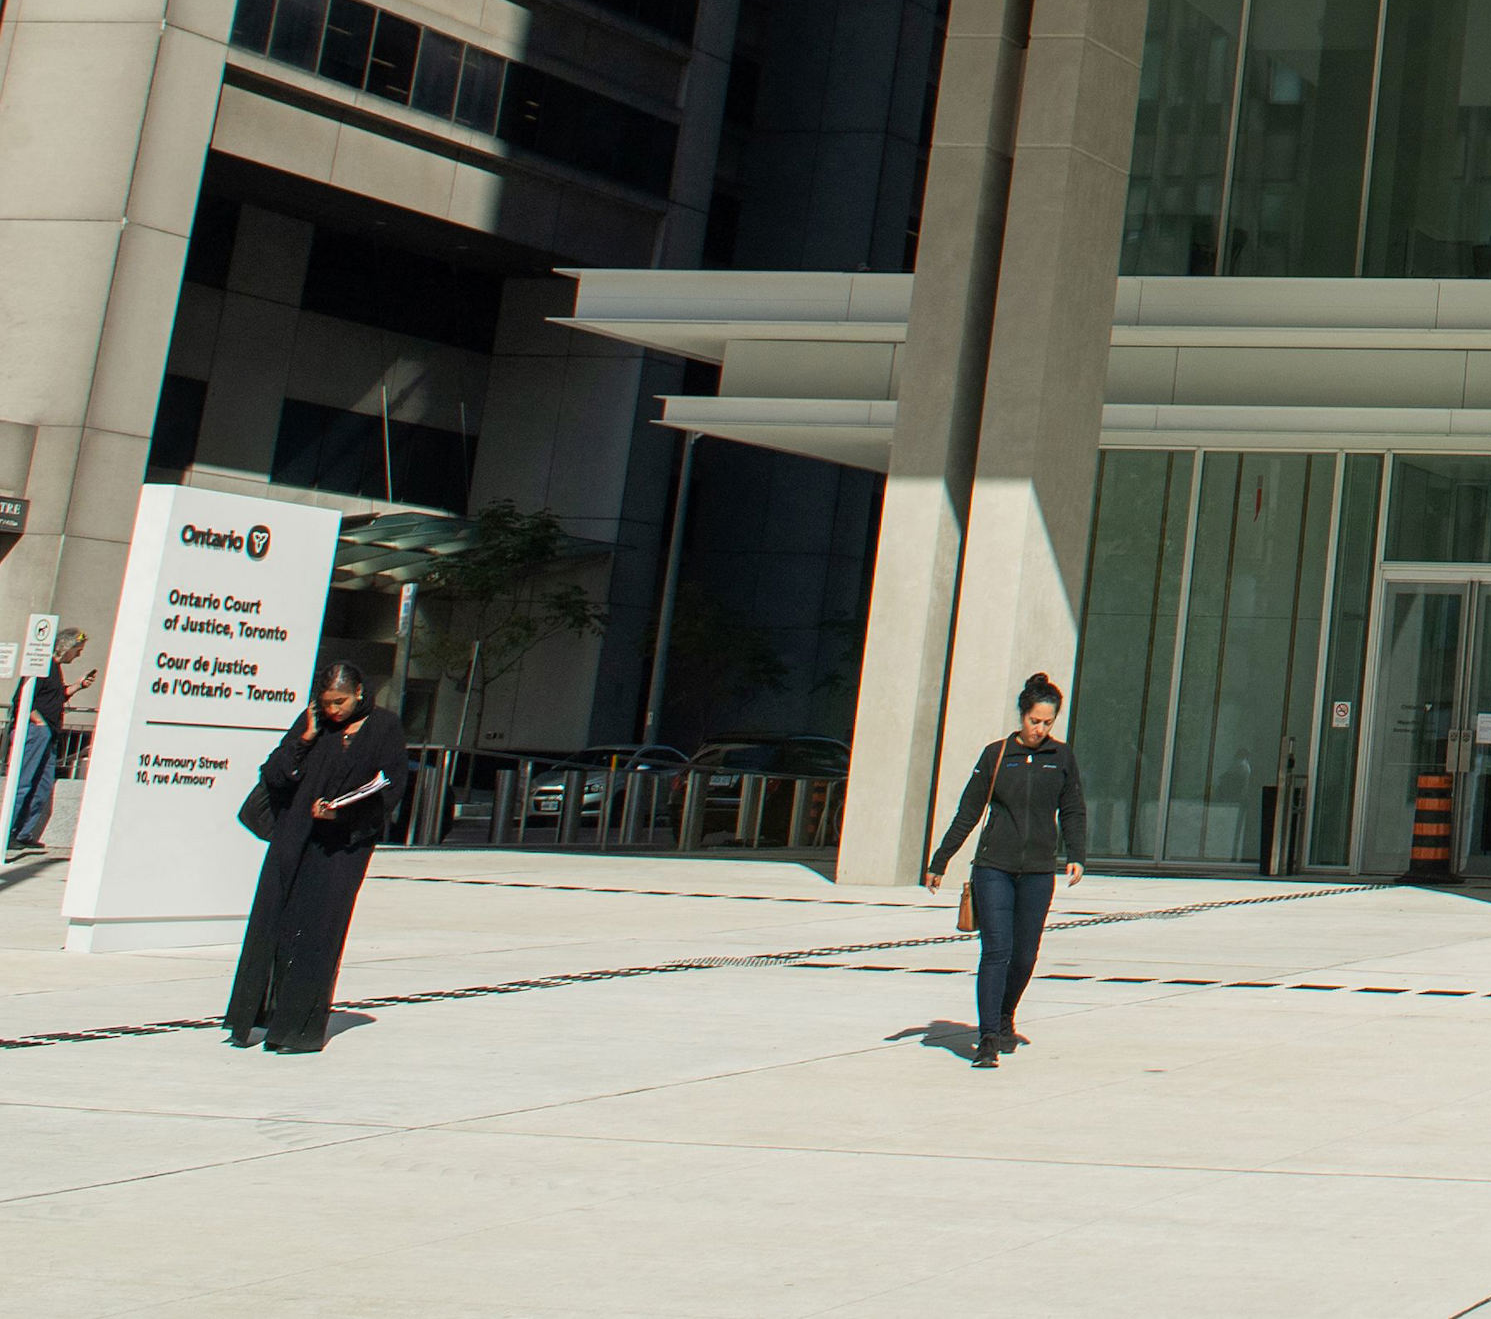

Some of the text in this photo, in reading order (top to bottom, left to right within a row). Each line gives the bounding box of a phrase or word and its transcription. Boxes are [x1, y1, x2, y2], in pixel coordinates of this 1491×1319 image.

[181, 524, 244, 552] Ontario
[169, 589, 261, 615] Ontario Court
[164, 615, 288, 642] of Justice, Toronto
[157, 652, 258, 677] Cour de justice
[152, 678, 169, 696] de
[173, 678, 231, 700] l'Ontario
[246, 683, 296, 704] Toronto
[139, 753, 229, 772] 10 Armoury Street
[136, 771, 215, 788] 10, rue Armoury
